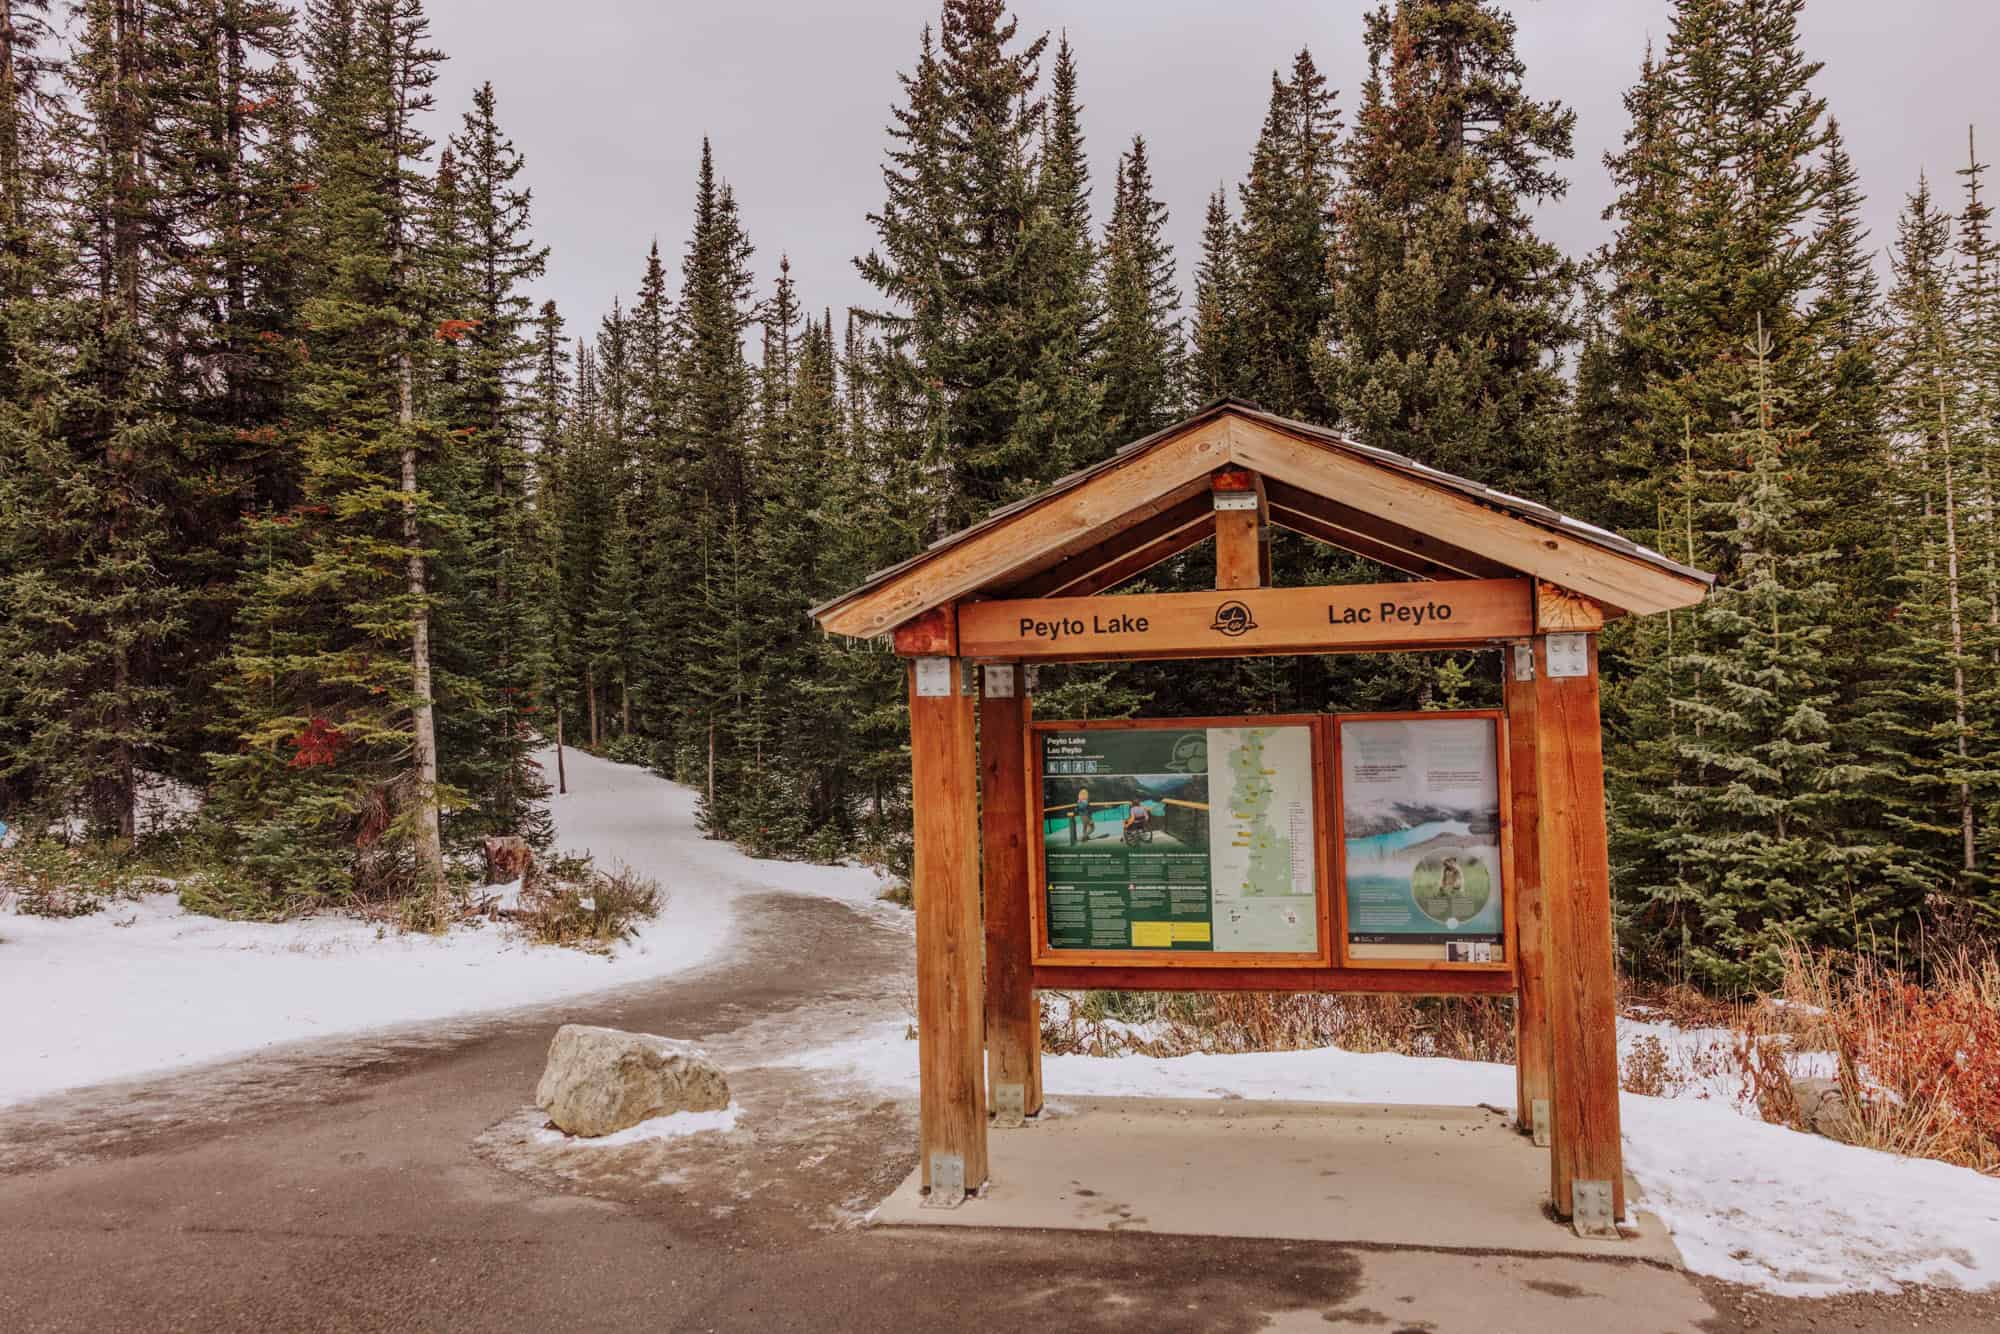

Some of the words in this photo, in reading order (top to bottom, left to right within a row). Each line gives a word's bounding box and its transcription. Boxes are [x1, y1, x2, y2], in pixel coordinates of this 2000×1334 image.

[1328, 604, 1371, 624] Lac
[1380, 602, 1452, 626] Peyto
[1019, 617, 1084, 640] Peyto
[1093, 614, 1149, 634] Lake
[1047, 738, 1067, 746] Peyto
[1068, 737, 1086, 745] Lake
[1061, 747, 1083, 755] Peyto
